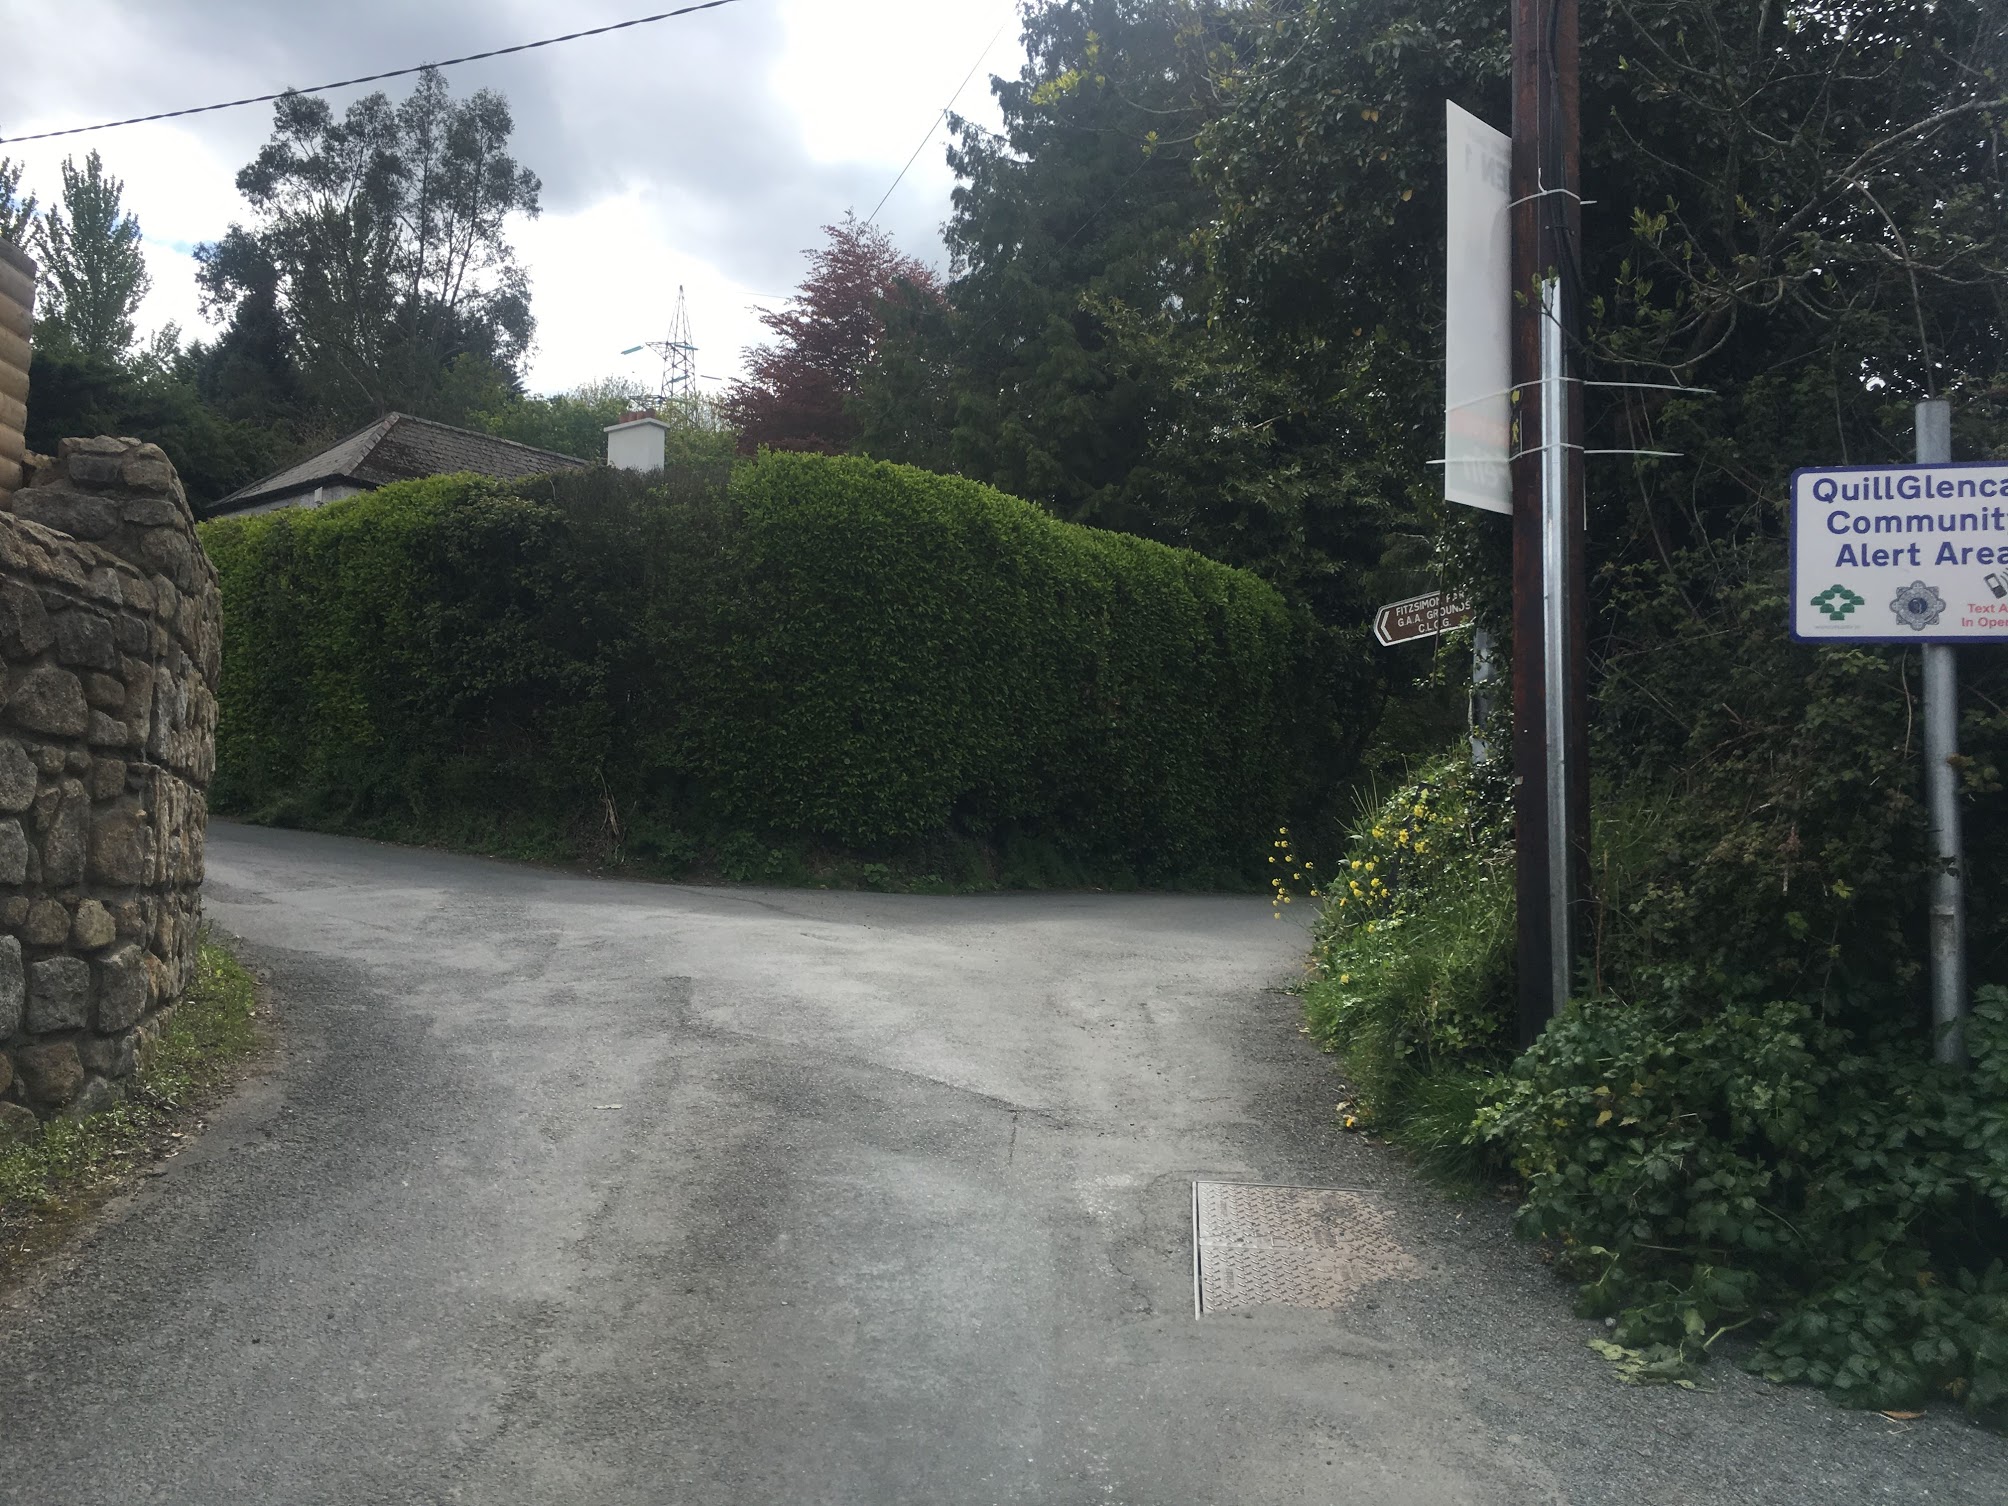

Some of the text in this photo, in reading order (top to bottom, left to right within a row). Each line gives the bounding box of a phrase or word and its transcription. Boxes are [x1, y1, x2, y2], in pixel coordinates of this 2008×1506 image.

[1827, 507, 2008, 535] Communit
[1835, 541, 2008, 568] Alert Area
[1968, 603, 1995, 613] Text
[1962, 617, 1974, 627] In
